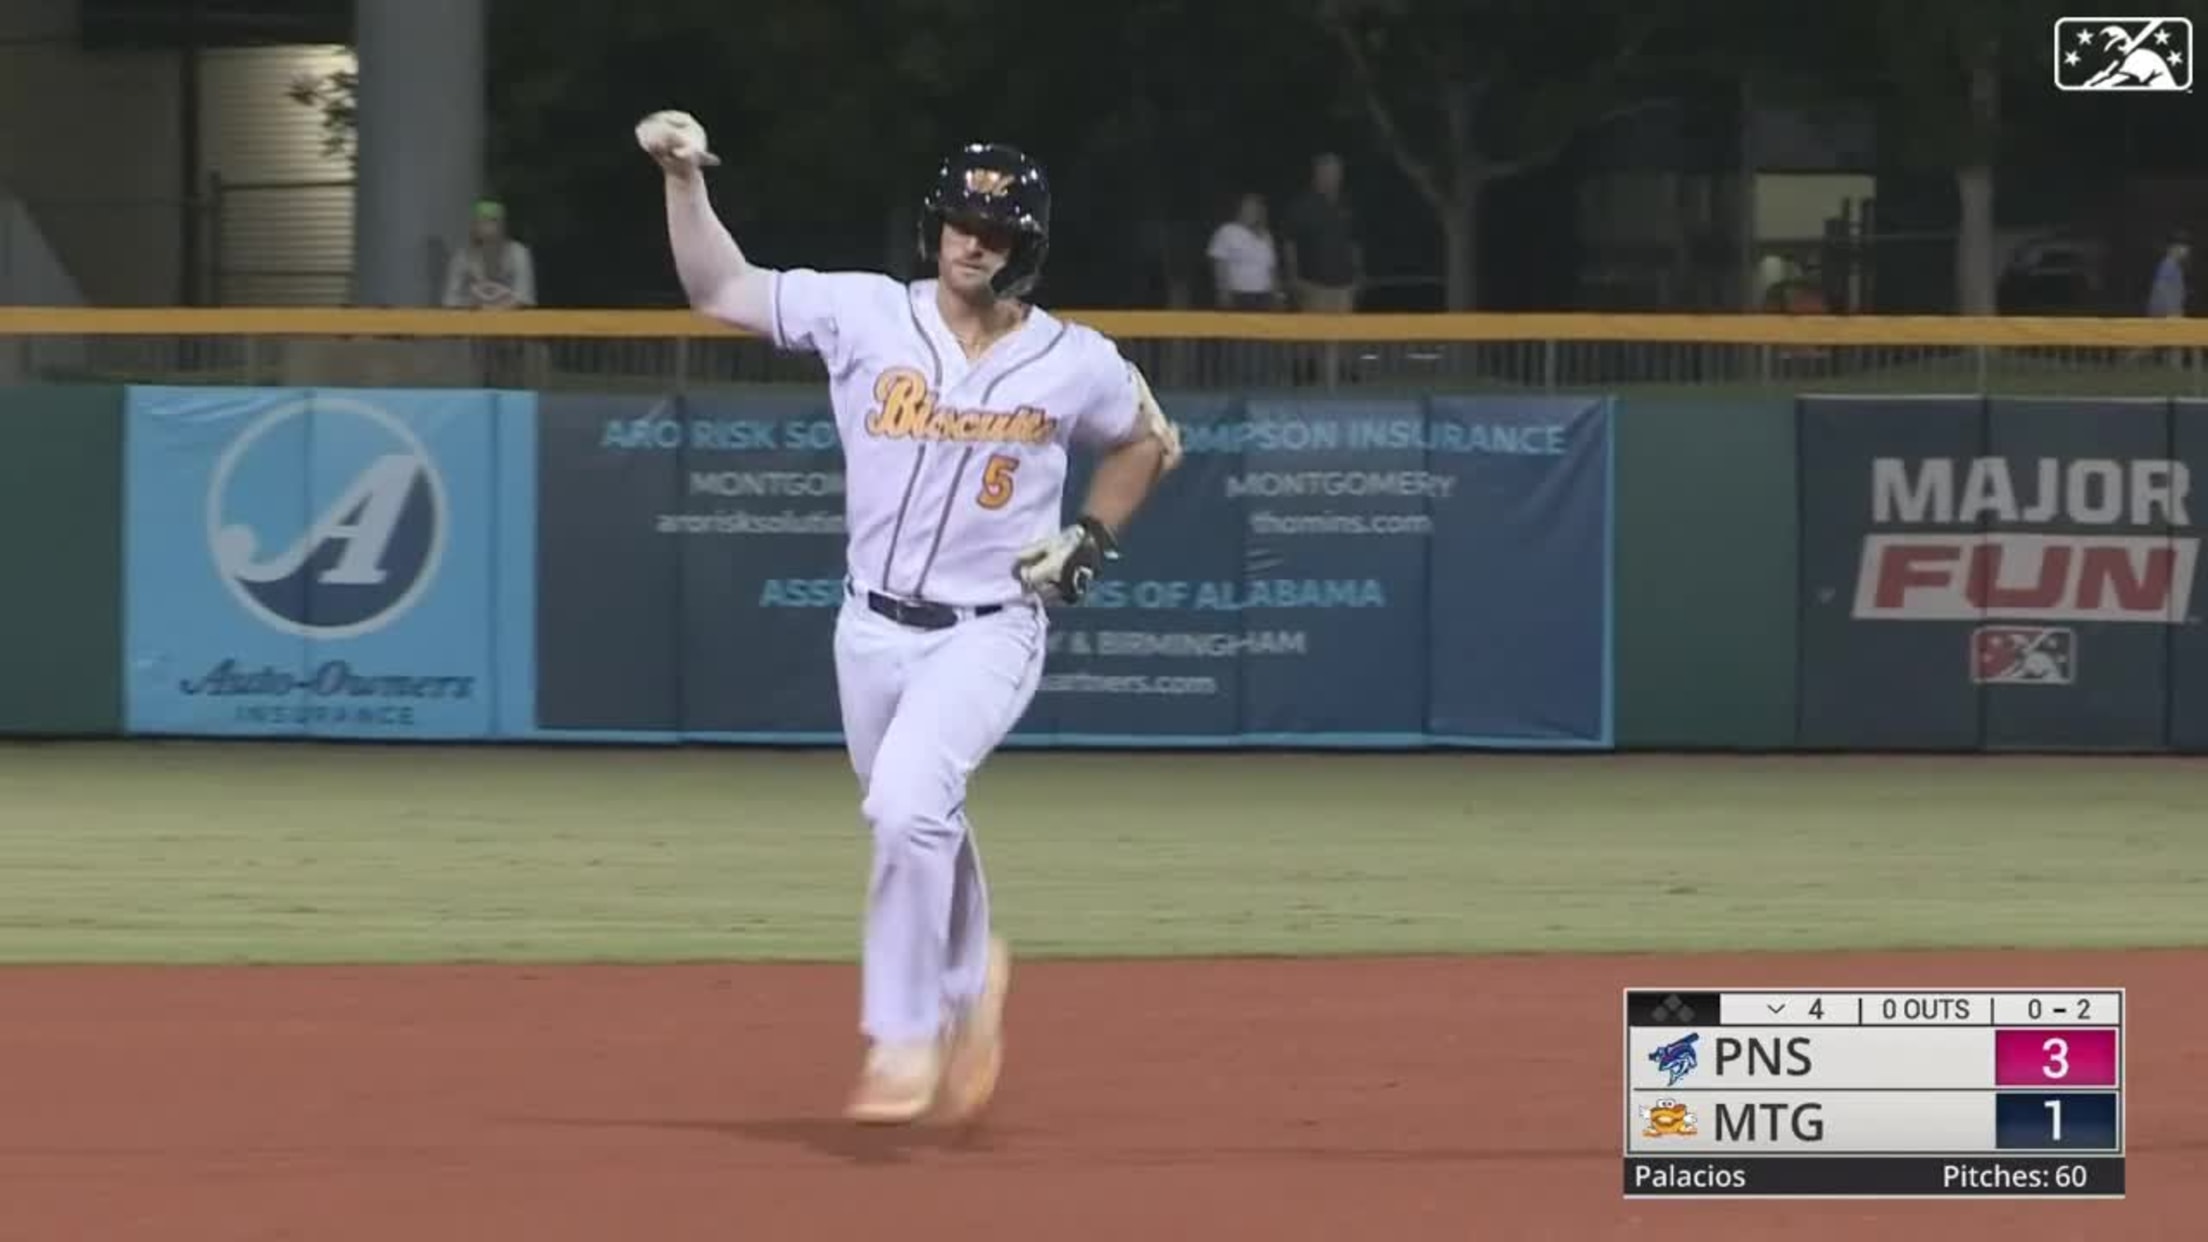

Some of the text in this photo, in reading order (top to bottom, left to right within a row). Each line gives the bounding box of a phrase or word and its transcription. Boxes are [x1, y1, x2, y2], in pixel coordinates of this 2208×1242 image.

[691, 419, 778, 451] RISK
[1347, 419, 1566, 456] INSURANCE
[976, 453, 1021, 510] 5
[1225, 470, 1456, 498] MONTGOMERY
[1872, 456, 2191, 526] MAJOR
[1250, 510, 1434, 535] thomins.com
[1873, 542, 2179, 612] FUN
[1132, 580, 1190, 609] OF
[1195, 578, 1386, 611] ALABAMA
[1097, 630, 1308, 658] BIRMINGHAM
[178, 658, 475, 698] Auto-Owners
[235, 705, 415, 726] INSURANCE
